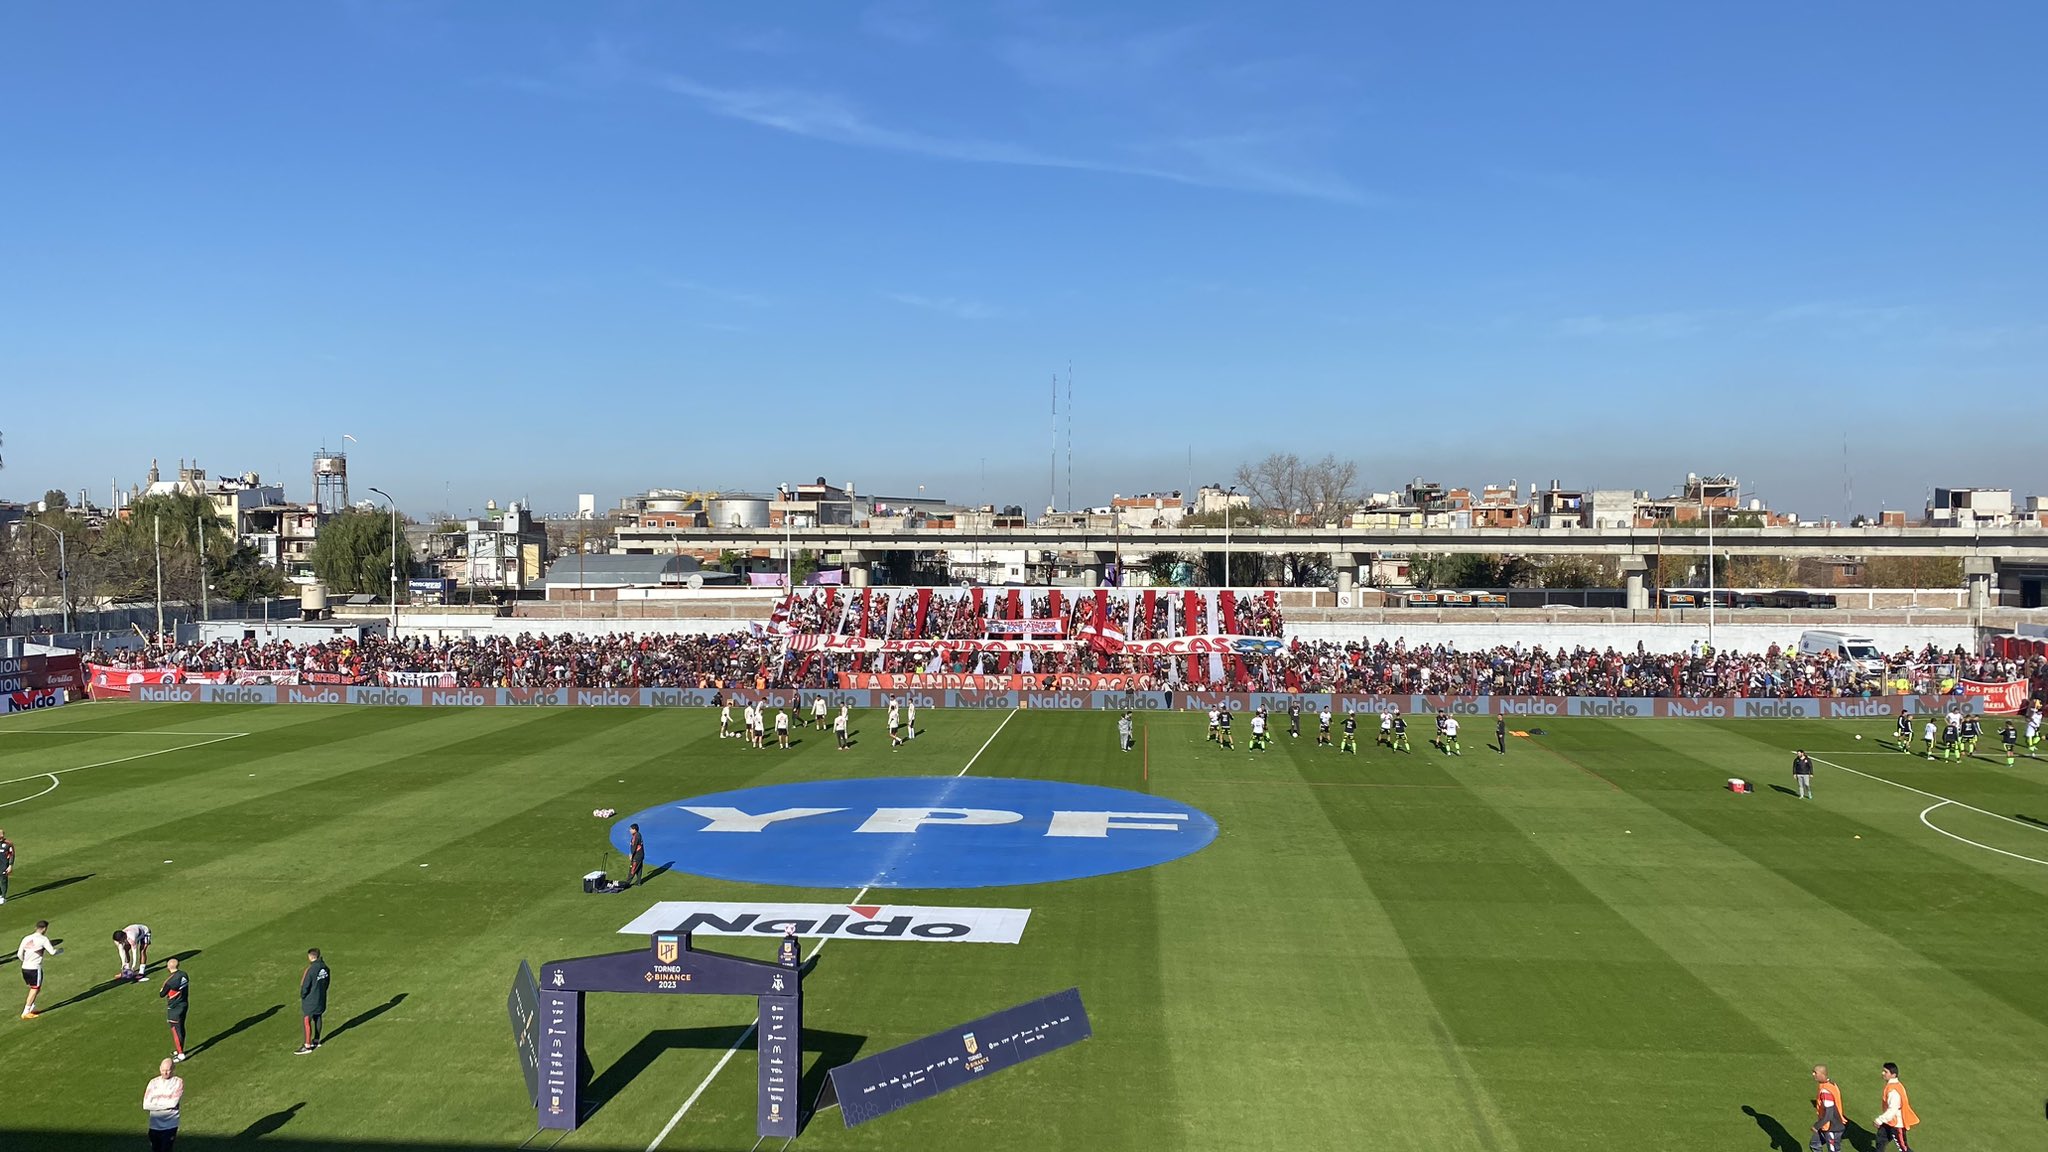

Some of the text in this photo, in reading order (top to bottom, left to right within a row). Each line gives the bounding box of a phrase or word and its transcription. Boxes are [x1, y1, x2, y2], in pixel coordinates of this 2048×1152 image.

[825, 635, 866, 649] LA
[891, 674, 977, 690] BANDA
[983, 675, 1012, 691] DE
[1021, 675, 1150, 691] BRRACAS
[1966, 684, 1981, 693] LOS
[140, 686, 192, 702] Naldo
[211, 687, 263, 703] Naldo
[357, 689, 409, 706] Naldo
[431, 689, 485, 706] Naldo
[577, 689, 631, 707] Naldo
[651, 689, 705, 707] Naldo
[731, 692, 785, 708] Ndo
[803, 691, 857, 708] Nldo
[880, 691, 935, 708] Naldo
[1028, 692, 1083, 710] Naldo
[1104, 693, 1159, 710] Nado
[1186, 694, 1242, 711] Ndo
[1261, 695, 1317, 712] Naldo
[1342, 697, 1399, 713] Naldo
[1421, 698, 1480, 715] Ndo
[1500, 698, 1558, 715] Naldo
[1580, 698, 1639, 717] Naldo
[1745, 699, 1805, 717] Naldo
[1830, 699, 1891, 717] Naldo
[1914, 698, 1974, 716] Ndo
[677, 806, 1189, 838] YPF
[672, 912, 972, 939] Naldo
[653, 965, 681, 973] TORNEO
[654, 973, 692, 981] BINANCE
[658, 981, 677, 989] 2023
